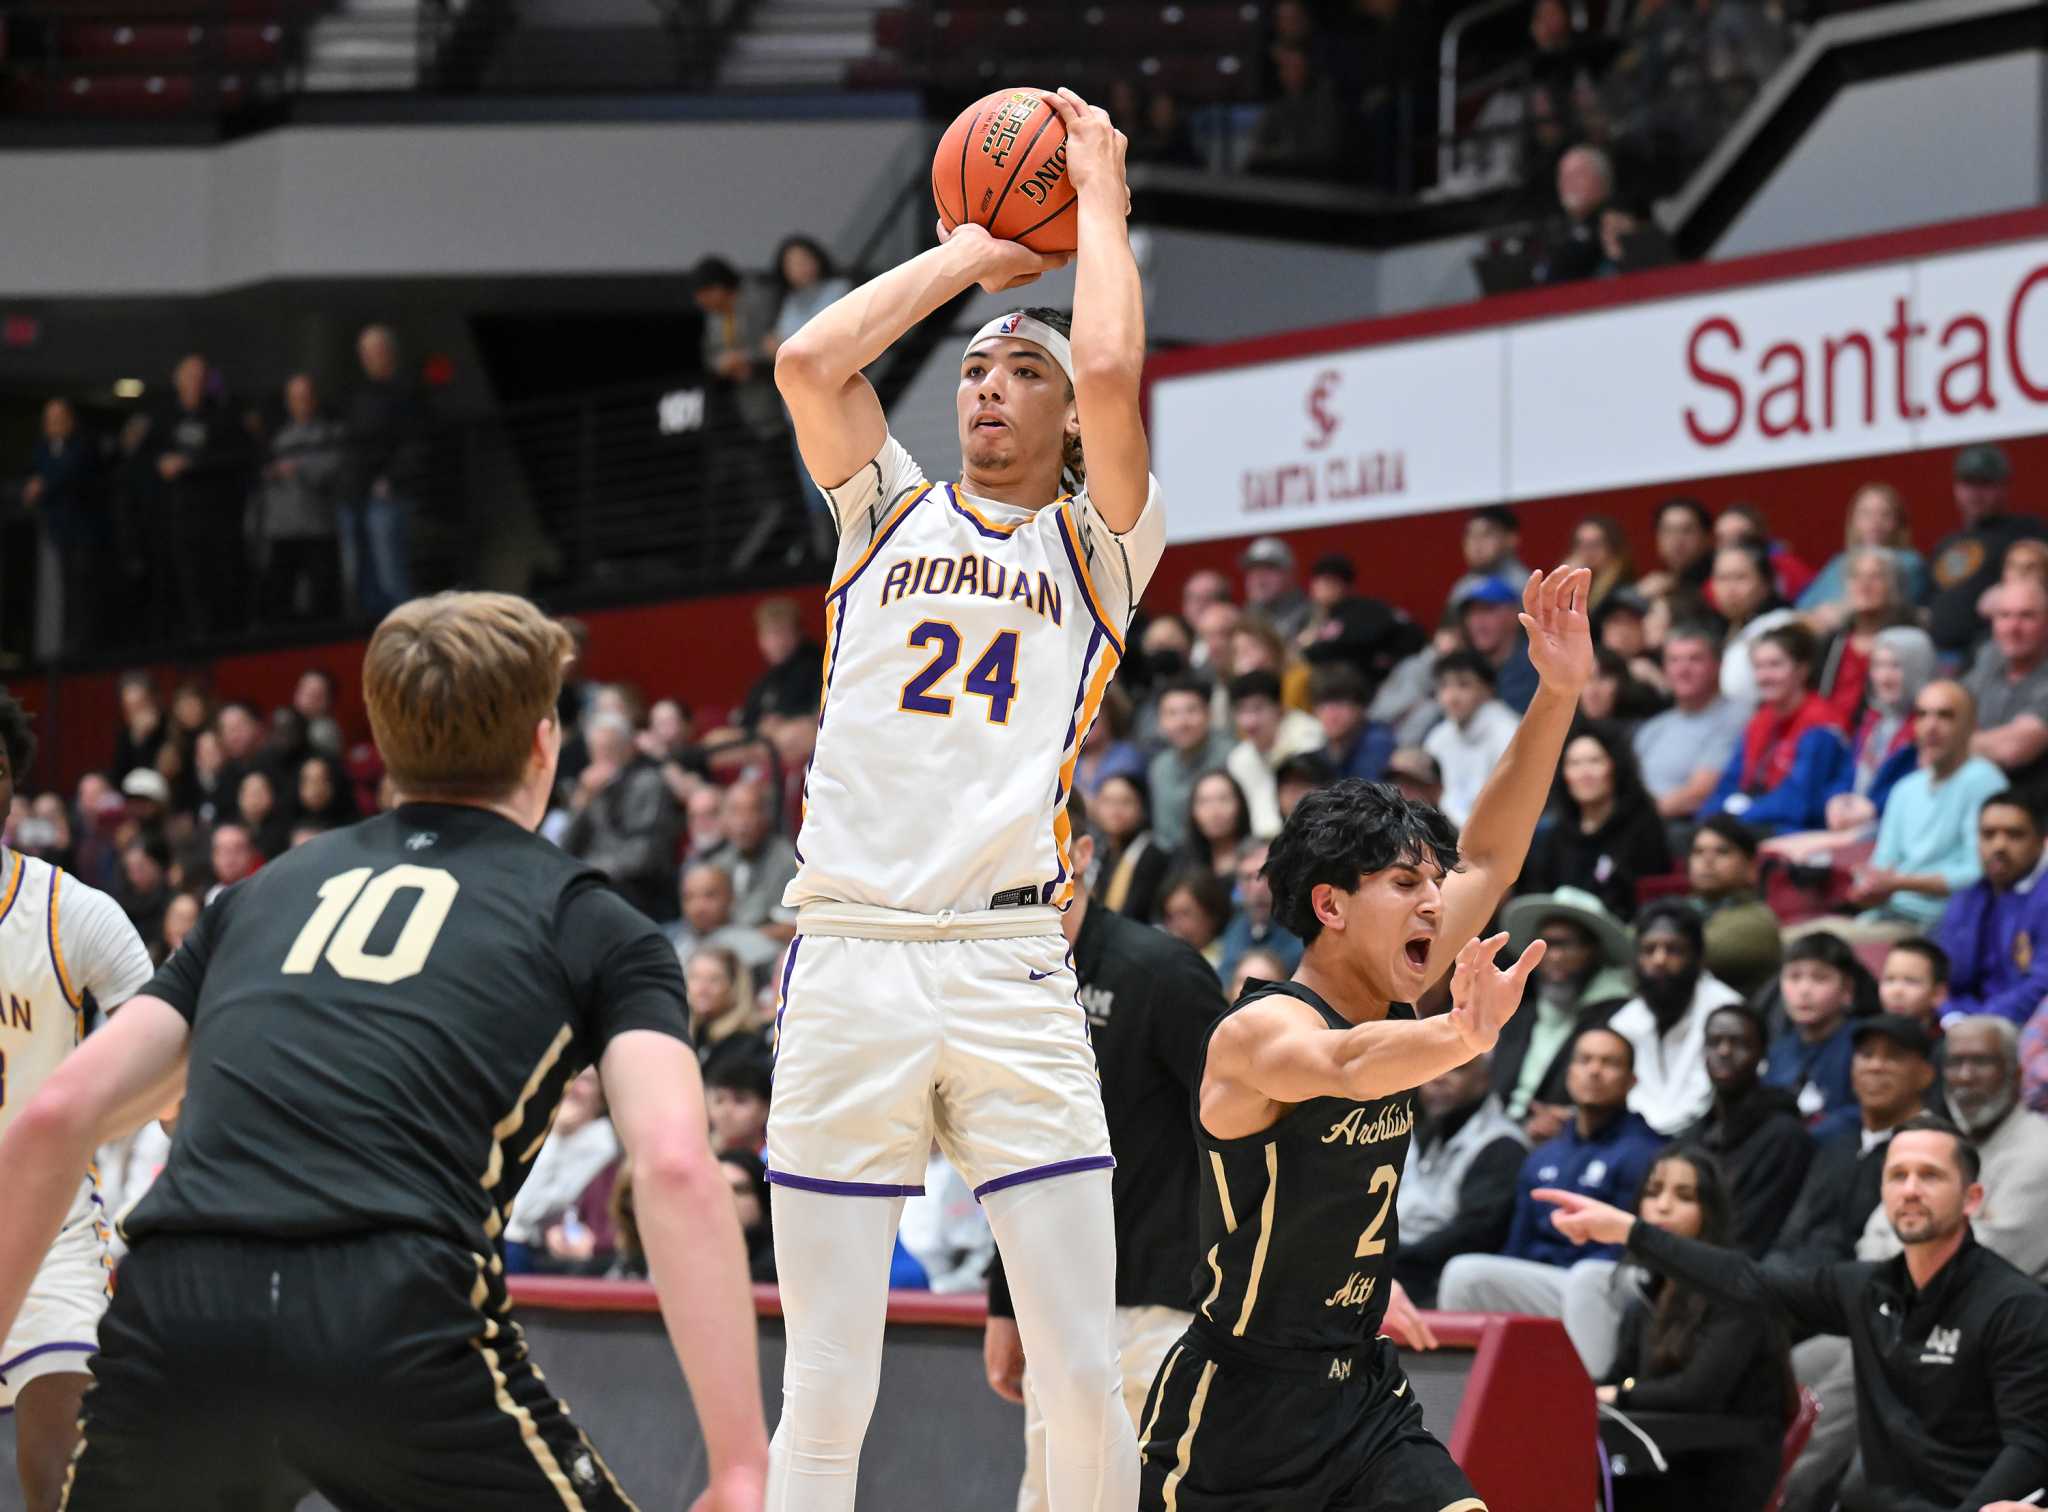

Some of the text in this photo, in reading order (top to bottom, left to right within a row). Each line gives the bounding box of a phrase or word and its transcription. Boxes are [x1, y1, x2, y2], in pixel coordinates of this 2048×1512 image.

[879, 552, 1062, 629] RIORDAN
[898, 617, 1023, 727] 24
[281, 863, 460, 985] 10
[1354, 1164, 1398, 1258] 2
